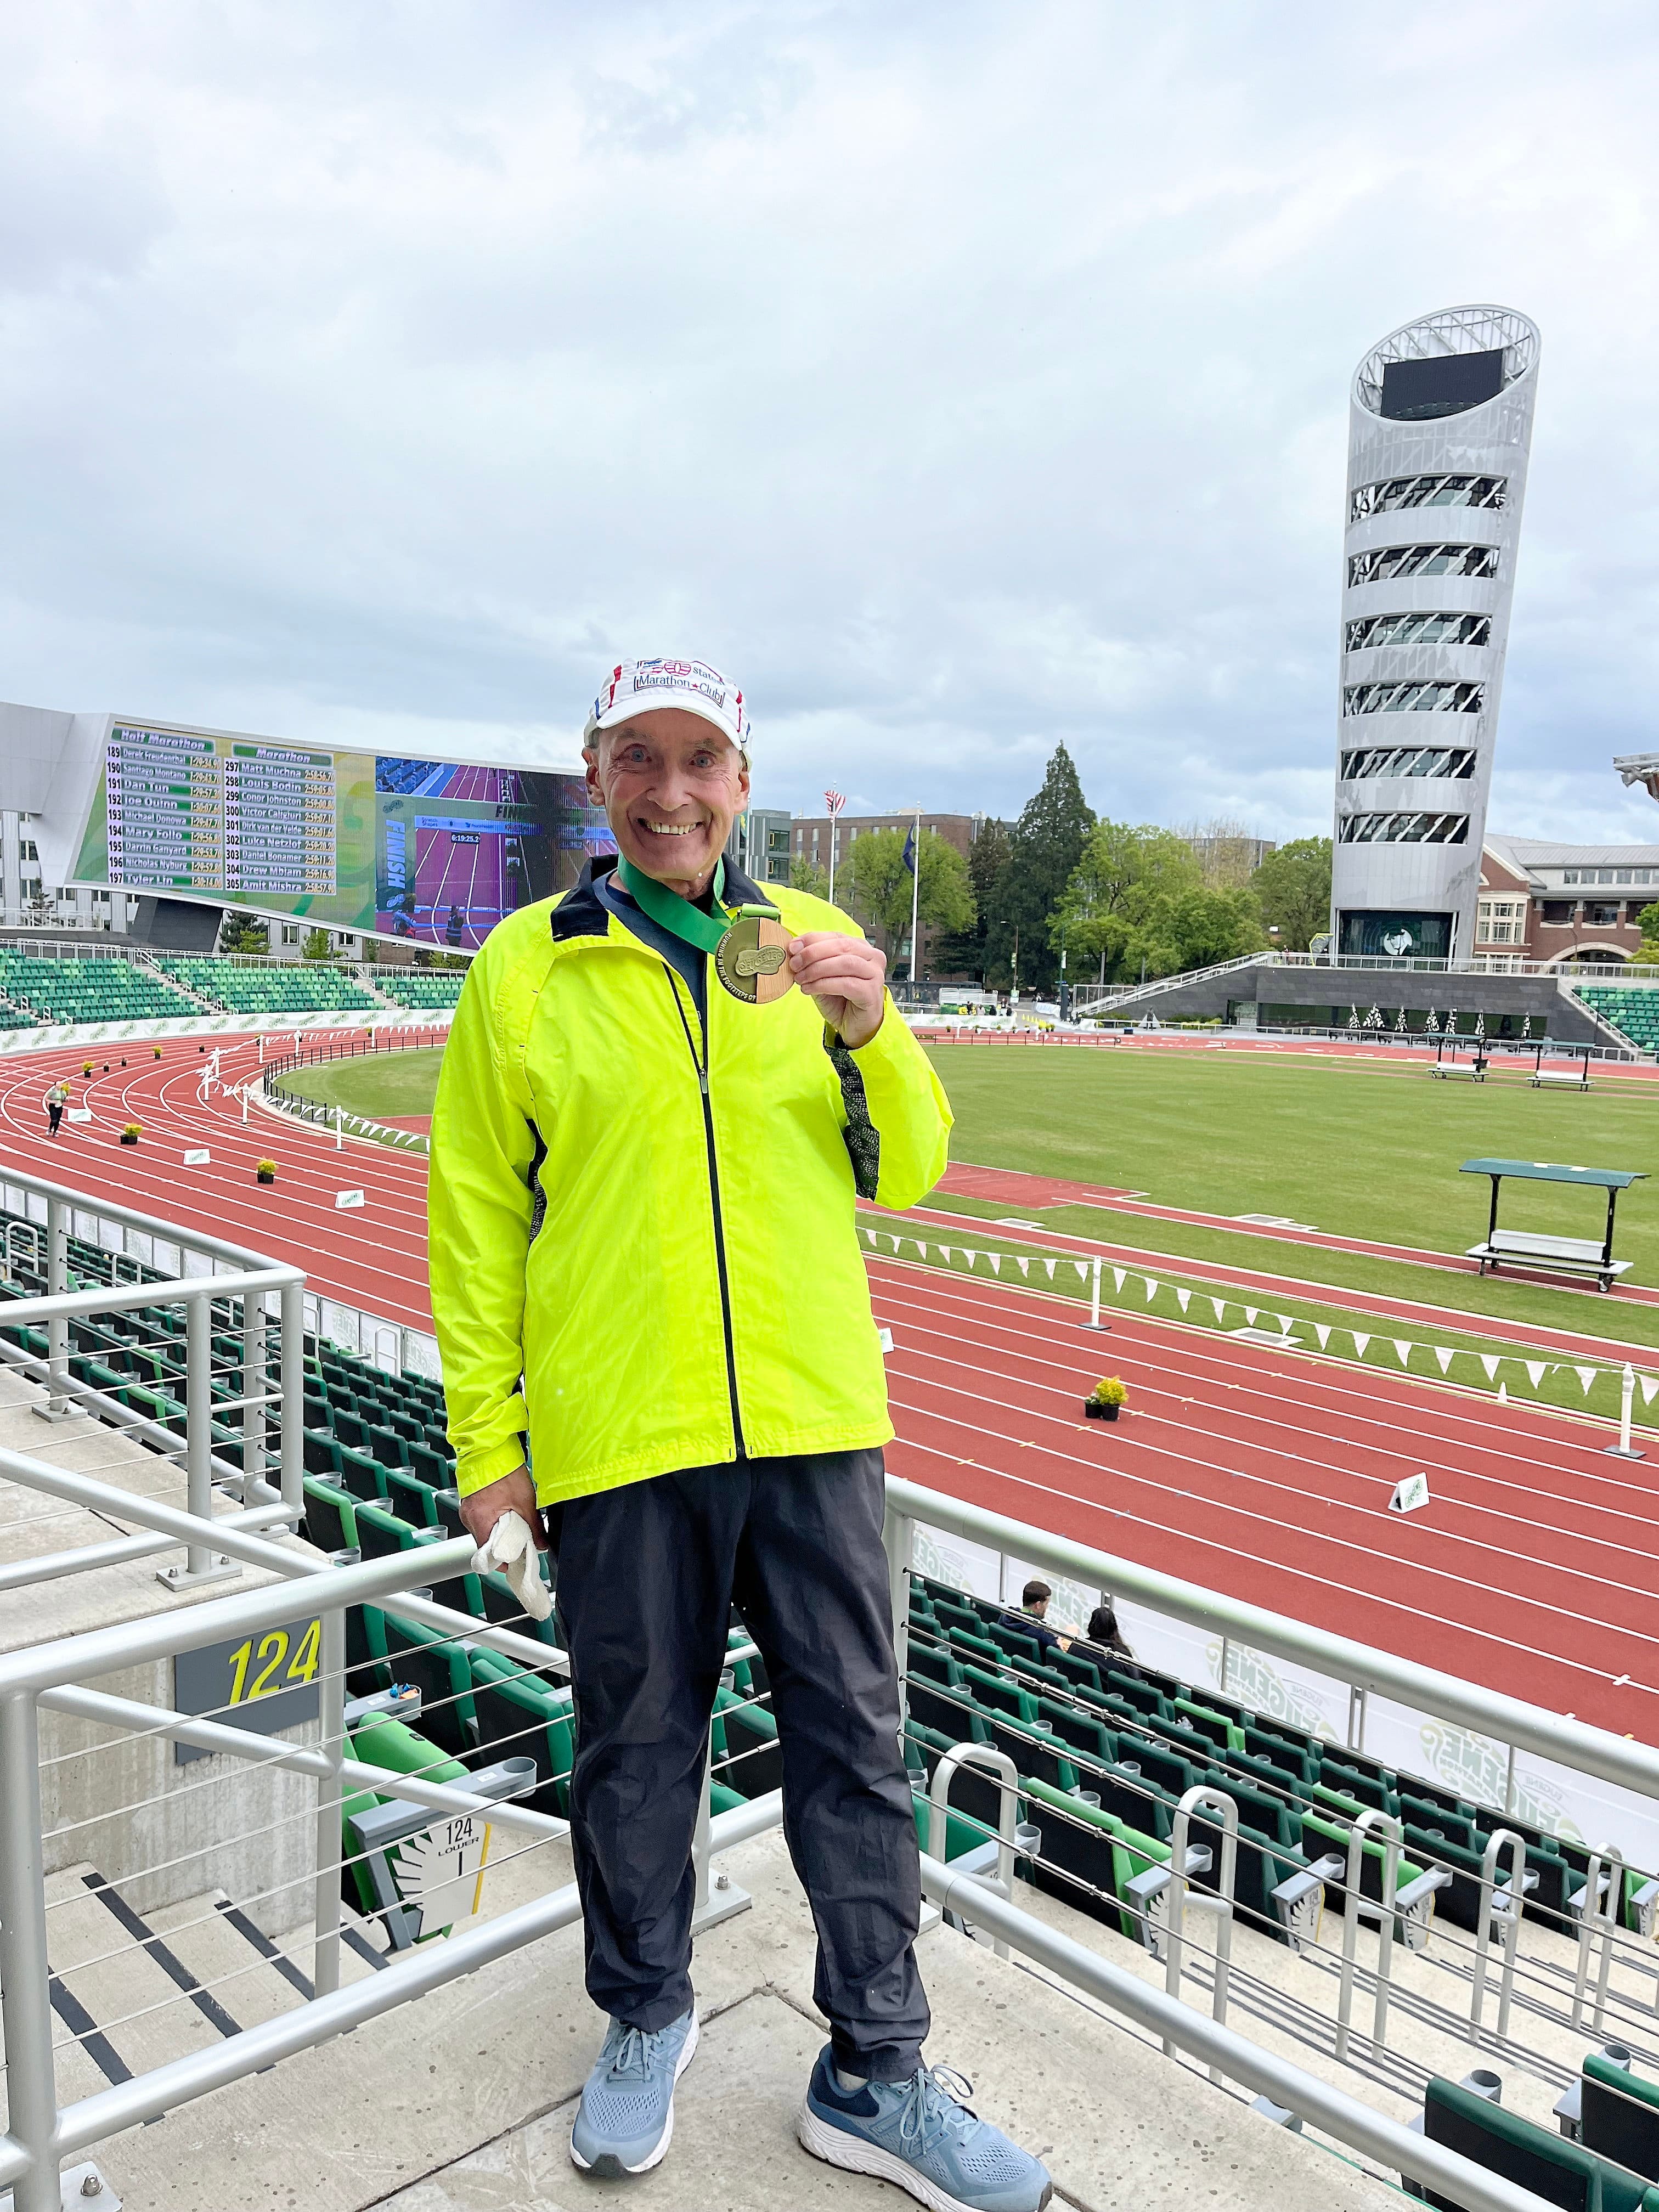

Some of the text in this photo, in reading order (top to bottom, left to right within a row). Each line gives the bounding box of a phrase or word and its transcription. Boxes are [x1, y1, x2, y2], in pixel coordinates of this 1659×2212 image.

[639, 675, 720, 701] Marathon Club
[121, 729, 205, 751] Half Marathon
[108, 746, 120, 758] 189
[256, 747, 311, 763] Marathon
[108, 762, 120, 774] 190
[123, 764, 154, 778] Santiago
[155, 768, 185, 780] Montano
[225, 761, 238, 772] 297
[241, 763, 263, 774] Matt
[265, 765, 301, 778] Muchna
[108, 777, 120, 789] 191
[124, 780, 145, 790] Dan
[225, 776, 239, 786] 298
[241, 777, 269, 788] Louis
[272, 780, 301, 792] Bodin
[108, 794, 121, 805] 192
[125, 797, 142, 806] Joe
[144, 797, 177, 809] Quinn
[226, 791, 239, 802] 299
[241, 792, 265, 802] Conor
[266, 794, 301, 806] Johnston
[109, 809, 121, 820] 193
[125, 810, 154, 822] Michael
[226, 806, 239, 816] 300
[242, 806, 267, 817] Victor
[109, 825, 121, 836] 194
[126, 827, 153, 840] Mary
[156, 828, 182, 840] Follo
[226, 820, 239, 831] 301
[242, 821, 256, 832] Dirk
[257, 823, 270, 833] van
[270, 823, 282, 833] der
[283, 824, 302, 834] Velde
[226, 835, 239, 845] 302
[242, 836, 265, 846] Luke
[109, 841, 121, 851] 195
[126, 842, 151, 853] Darrin
[153, 843, 187, 856] Ganyard
[226, 850, 239, 860] 303
[242, 850, 266, 861] Daniel
[386, 819, 406, 889] FINISH
[110, 856, 122, 867] 196
[126, 857, 158, 868] Nicholas
[226, 864, 239, 874] 304
[242, 865, 268, 876] Drew
[110, 872, 122, 883] 197
[126, 873, 154, 885] Tyler
[157, 874, 173, 885] Lin
[227, 879, 239, 889] 305
[242, 880, 266, 890] Amit
[268, 881, 302, 892] Mishra
[718, 932, 732, 957] RUNNING
[723, 977, 748, 998] FOOTSTEPS
[228, 1620, 320, 1706] 124
[447, 1818, 472, 1844] 124
[438, 1837, 479, 1857] LOWER
